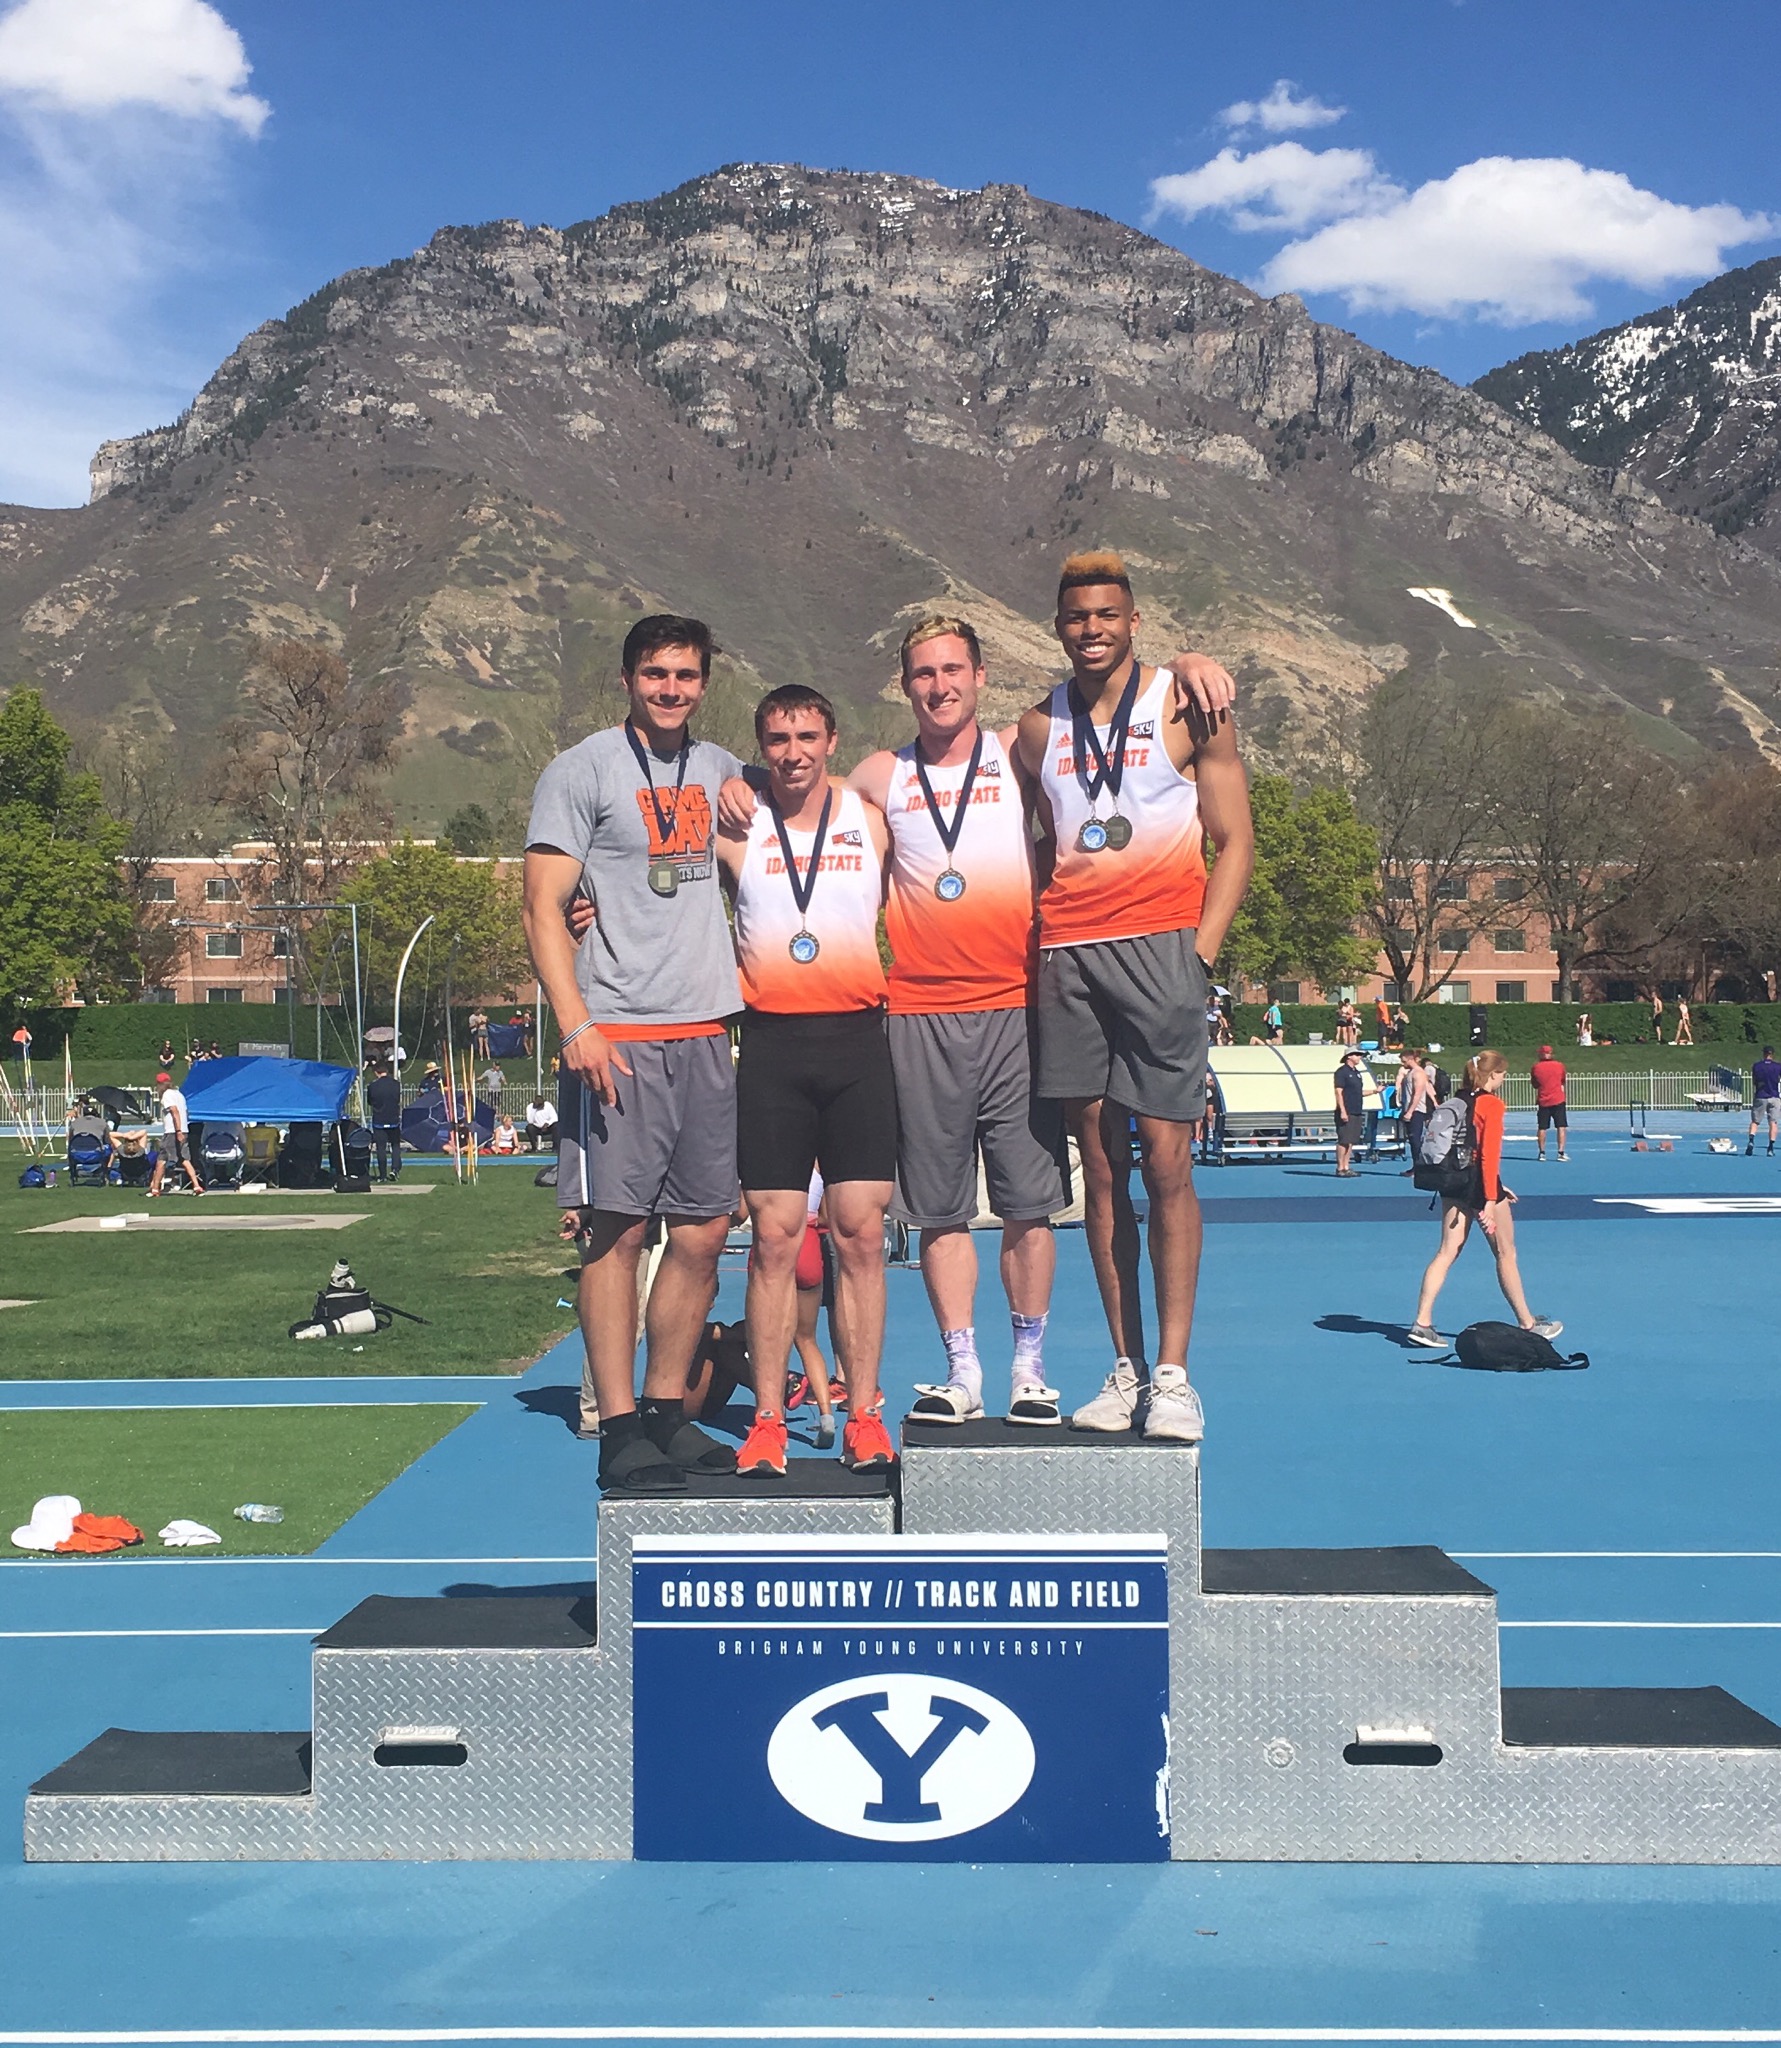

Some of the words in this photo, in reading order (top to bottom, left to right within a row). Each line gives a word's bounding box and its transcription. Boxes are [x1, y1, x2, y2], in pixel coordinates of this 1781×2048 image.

[1133, 722, 1153, 736] SKY
[1107, 749, 1150, 768] SATE
[636, 784, 710, 814] GAME
[954, 786, 1001, 805] SATE
[843, 830, 861, 843] SKY
[815, 854, 862, 872] STATE
[661, 1580, 745, 1608] CROSS
[756, 1580, 873, 1608] COUNTRY
[914, 1580, 998, 1608] TRACK
[1009, 1580, 1059, 1608] AND
[1071, 1580, 1140, 1608] FIELD
[718, 1640, 824, 1655] BRIGHAM
[843, 1640, 917, 1655] YOUNG
[937, 1640, 1083, 1656] UNIVERSITY
[811, 1691, 990, 1823] Y
